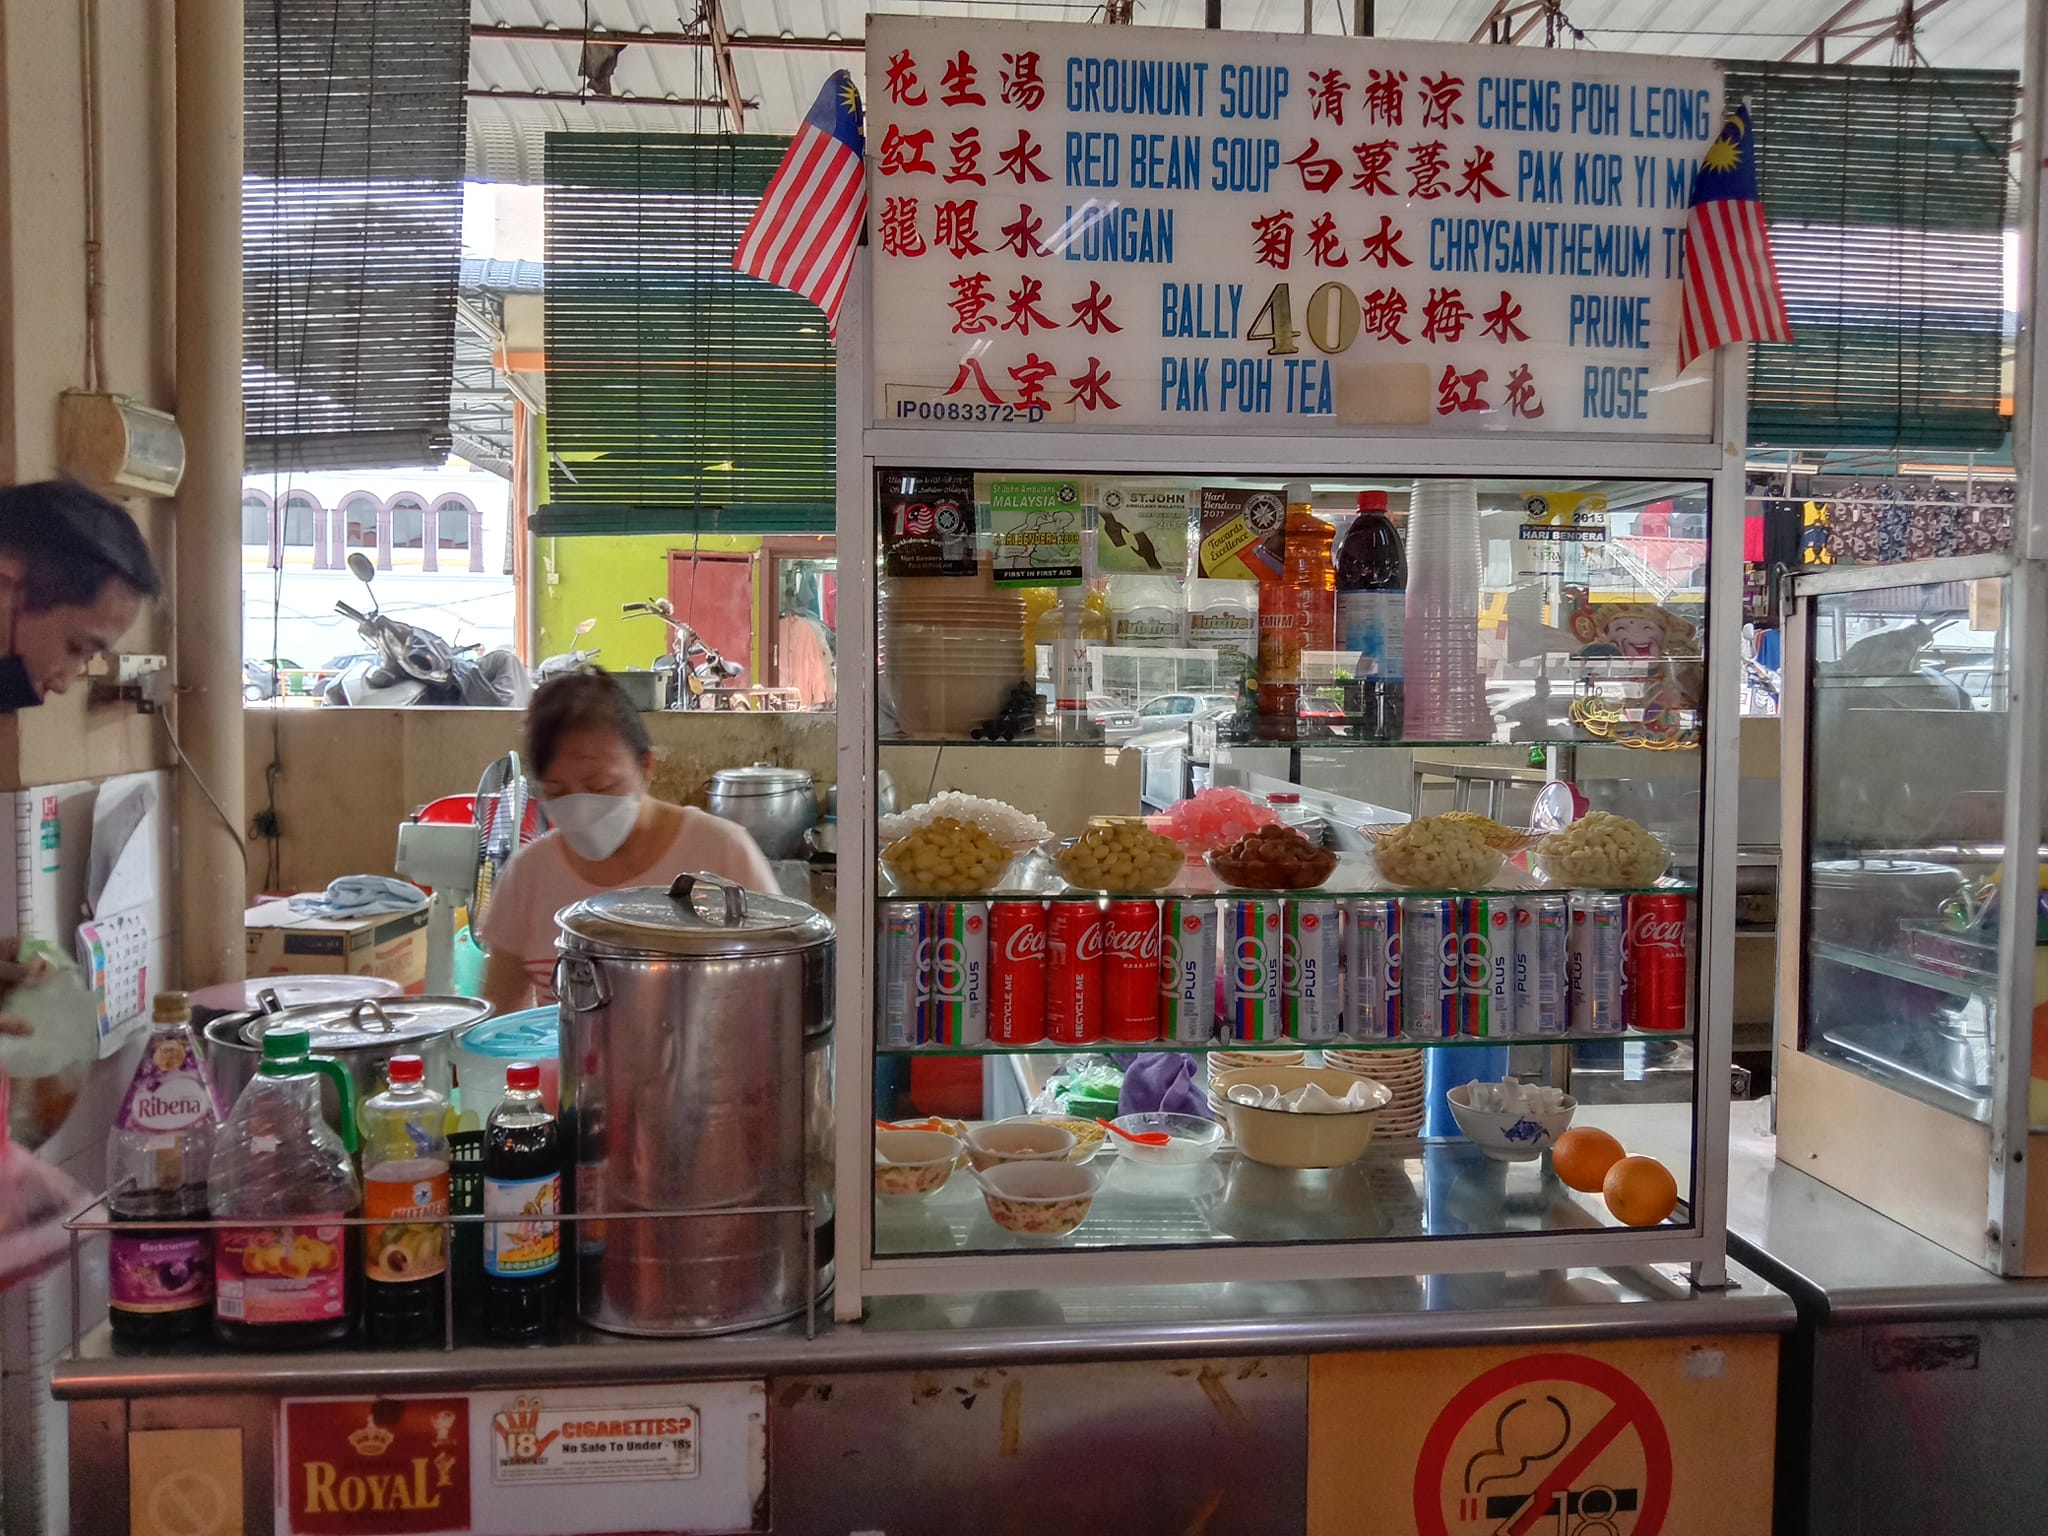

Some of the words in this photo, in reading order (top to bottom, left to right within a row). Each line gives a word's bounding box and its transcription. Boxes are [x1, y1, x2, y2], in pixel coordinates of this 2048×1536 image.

[883, 48, 1046, 112] 花生湯
[1066, 56, 1209, 117] GROUNUNT
[1220, 64, 1289, 120] SOUP
[1307, 67, 1465, 130] 清補涼
[1477, 77, 1561, 134] CHENG
[1571, 82, 1619, 136] POH
[1629, 86, 1710, 142] LEONG
[1066, 131, 1120, 188] RED
[1130, 133, 1201, 190] BEAN
[1211, 137, 1281, 193] SOUP
[1517, 149, 1563, 204] PAK
[1573, 153, 1623, 207] KOR
[1634, 155, 1656, 208] YI
[877, 196, 1056, 260] 龍眼水
[1064, 206, 1175, 264] LONGAN
[1250, 208, 1415, 271] 菊花水
[1429, 217, 1651, 279] CHRYSANTHEMUM
[946, 271, 1124, 337] 薏米水
[1161, 282, 1243, 340] BALLY
[1246, 281, 1362, 356] 40
[1361, 286, 1532, 346] 酸梅水
[1569, 293, 1651, 349] PRUNE
[1160, 356, 1209, 412] PAK
[1220, 358, 1273, 414] POH
[1284, 359, 1333, 415] TEA
[1582, 366, 1650, 420] ROSE
[896, 401, 1044, 423] IP0083372-D
[993, 495, 1056, 508] MALAYSIA
[1129, 493, 1185, 504] ST.JOHN
[1203, 491, 1226, 501] Hari
[1203, 500, 1242, 510] Bendera
[1203, 510, 1225, 518] 2017
[1207, 522, 1244, 550] Towards
[1522, 531, 1549, 540] HARI
[1552, 531, 1604, 541] BENDERA
[1573, 513, 1605, 524] 2013
[1259, 614, 1294, 628] EMIUM
[969, 960, 980, 1002] PLUS
[1004, 973, 1013, 991] ME
[1076, 972, 1085, 990] ME
[1184, 960, 1197, 1000] PLUS
[1233, 935, 1267, 1003] 100
[1269, 958, 1277, 999] PLUS
[1305, 958, 1316, 998] PLUS
[1495, 955, 1506, 996] PLUS
[1517, 952, 1528, 993] PLUS
[1573, 951, 1583, 991] PLUS
[1003, 991, 1012, 1039] RECYCLE
[1075, 991, 1084, 1039] RECYCLE
[138, 1096, 201, 1119] Ribena
[507, 1433, 538, 1458] 18
[561, 1417, 692, 1440] CIGARETTES?
[562, 1443, 578, 1454] No
[580, 1443, 607, 1454] Sale
[610, 1442, 624, 1452] To
[626, 1440, 662, 1452] Under
[671, 1439, 692, 1450] 18s
